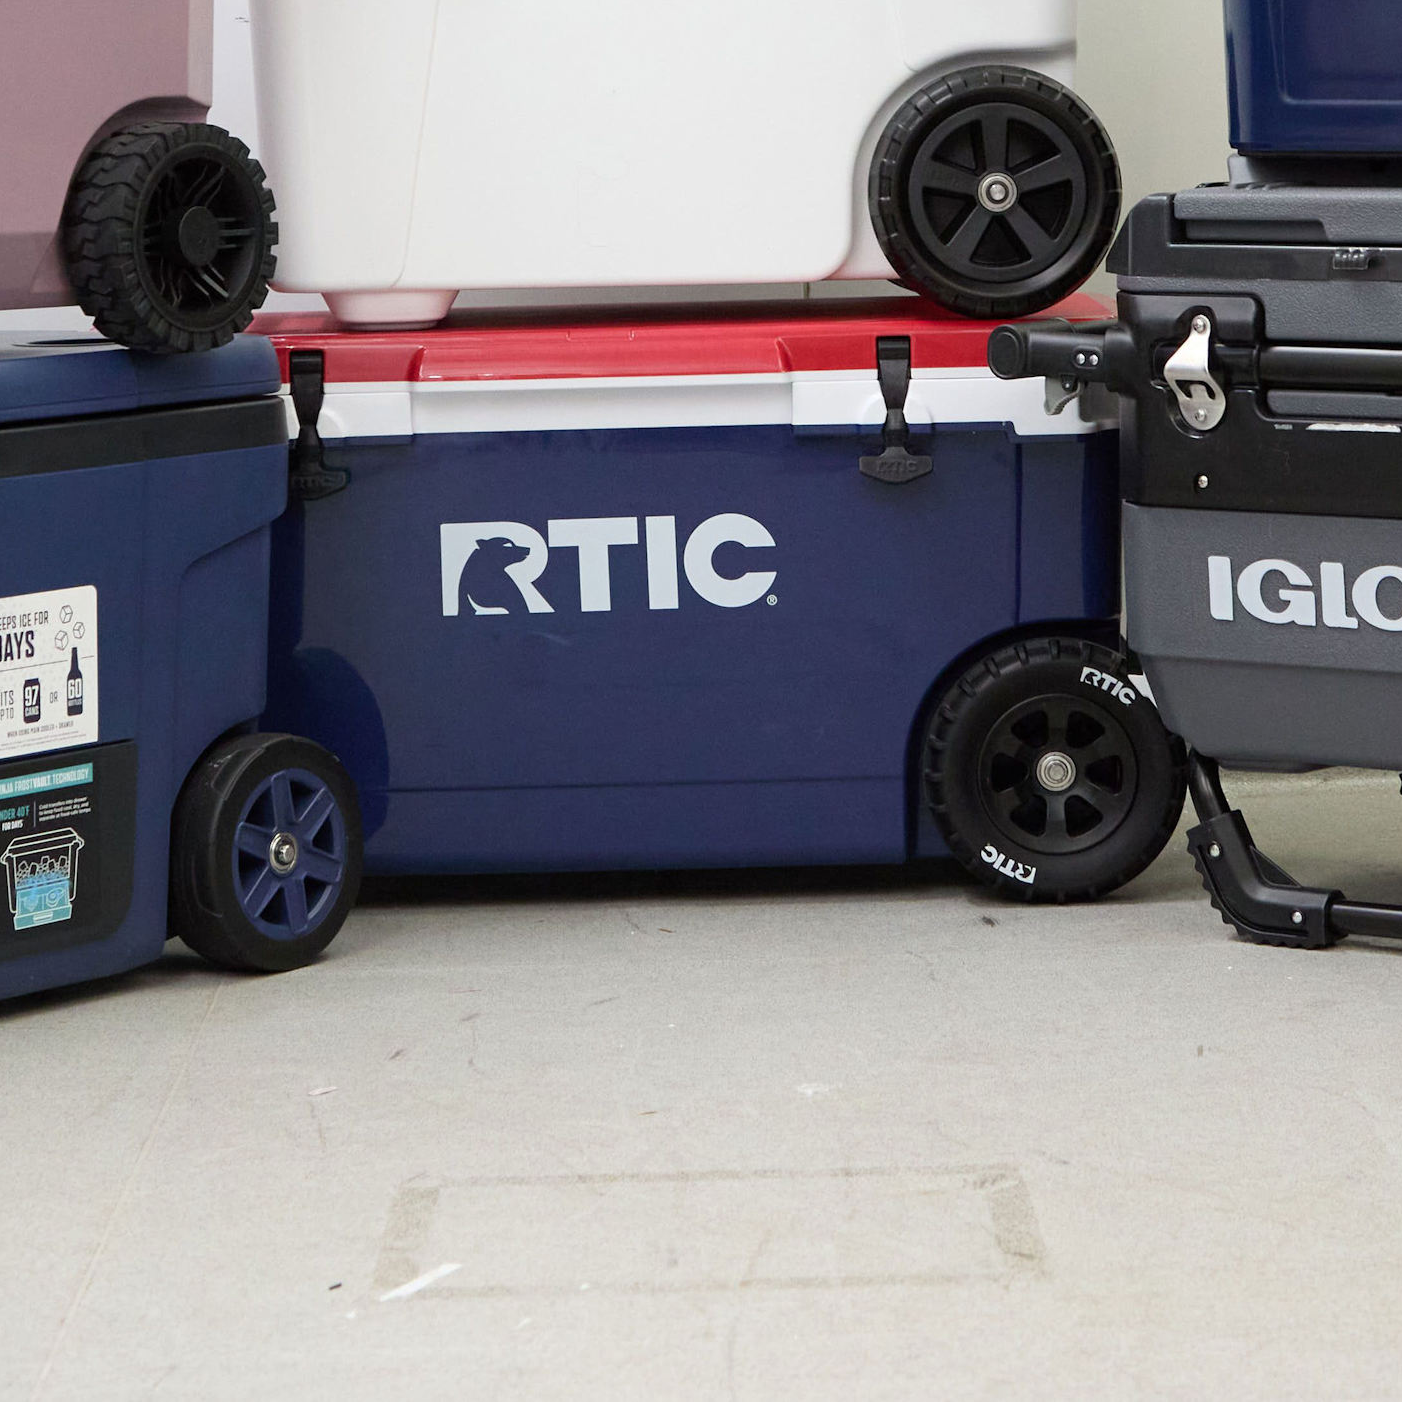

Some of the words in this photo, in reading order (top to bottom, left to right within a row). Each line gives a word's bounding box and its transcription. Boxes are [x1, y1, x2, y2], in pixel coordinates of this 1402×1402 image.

[440, 512, 777, 616] RTIC
[19, 612, 32, 628] ICE
[34, 610, 49, 625] FOR
[24, 685, 39, 707] 97
[68, 679, 82, 699] 60
[1080, 666, 1136, 705] RTIC
[49, 691, 58, 704] OR
[5, 707, 14, 719] TO
[14, 774, 52, 792] FROSTVAULT
[52, 768, 89, 785] TECHNOLOGY
[1, 822, 11, 832] FOR
[980, 844, 1037, 884] RTIC
